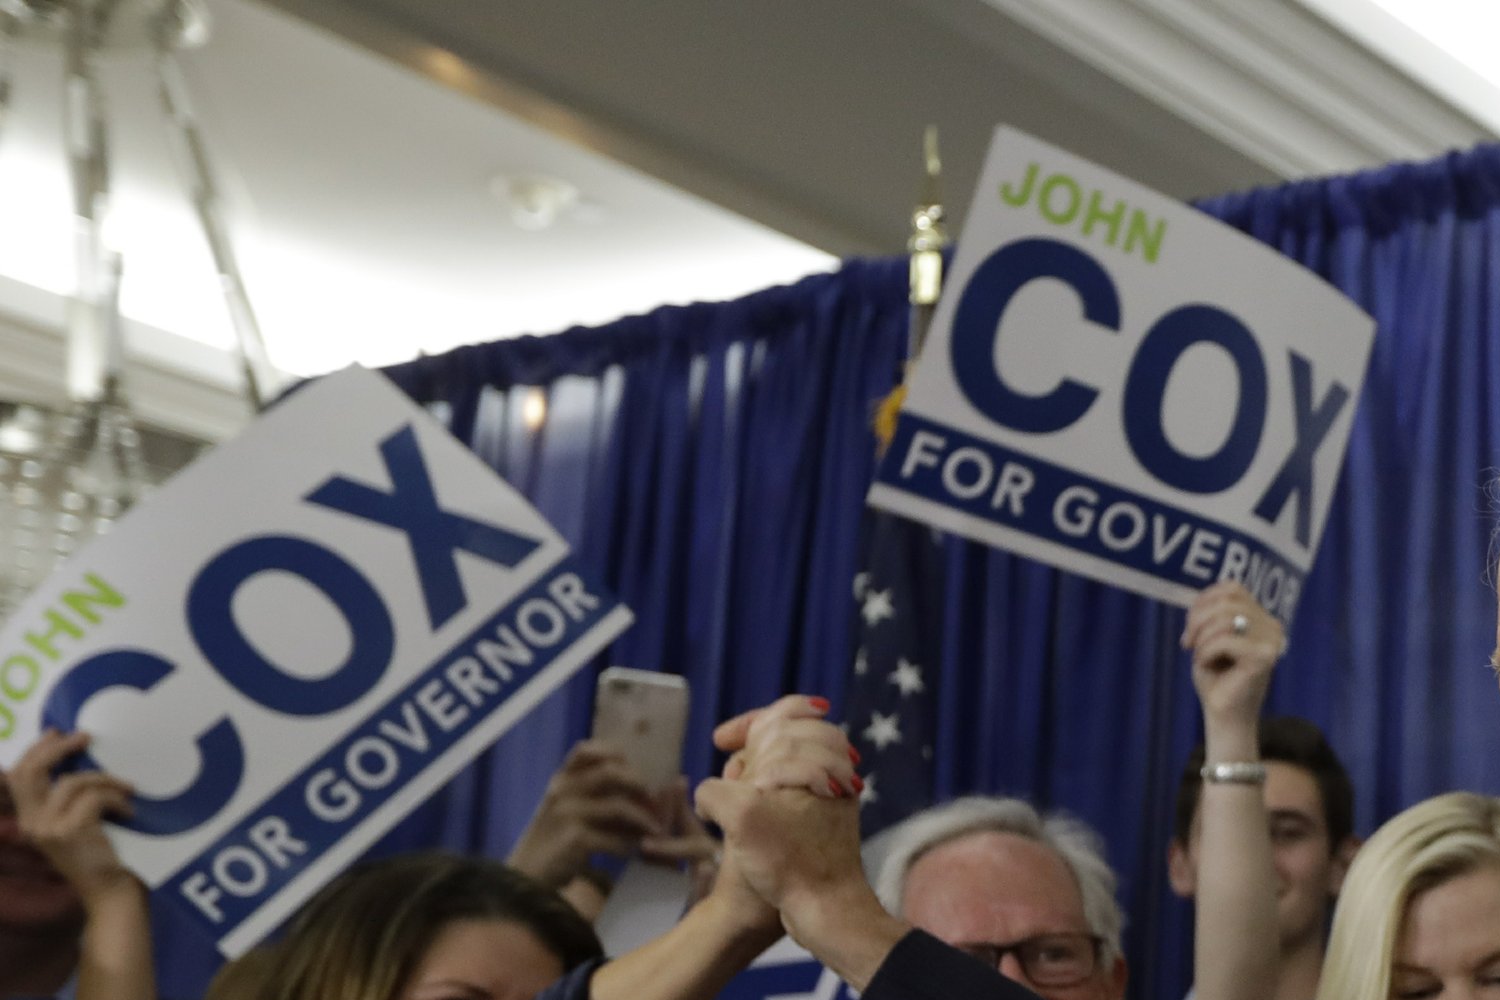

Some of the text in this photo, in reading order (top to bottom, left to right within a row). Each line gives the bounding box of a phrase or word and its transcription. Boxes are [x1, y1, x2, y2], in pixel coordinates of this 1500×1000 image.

[1000, 163, 1168, 264] JOHN
[901, 430, 1034, 517] FOR
[949, 236, 1352, 550] COX
[40, 422, 545, 836] COX
[180, 572, 600, 924] FOR GOVERNOR
